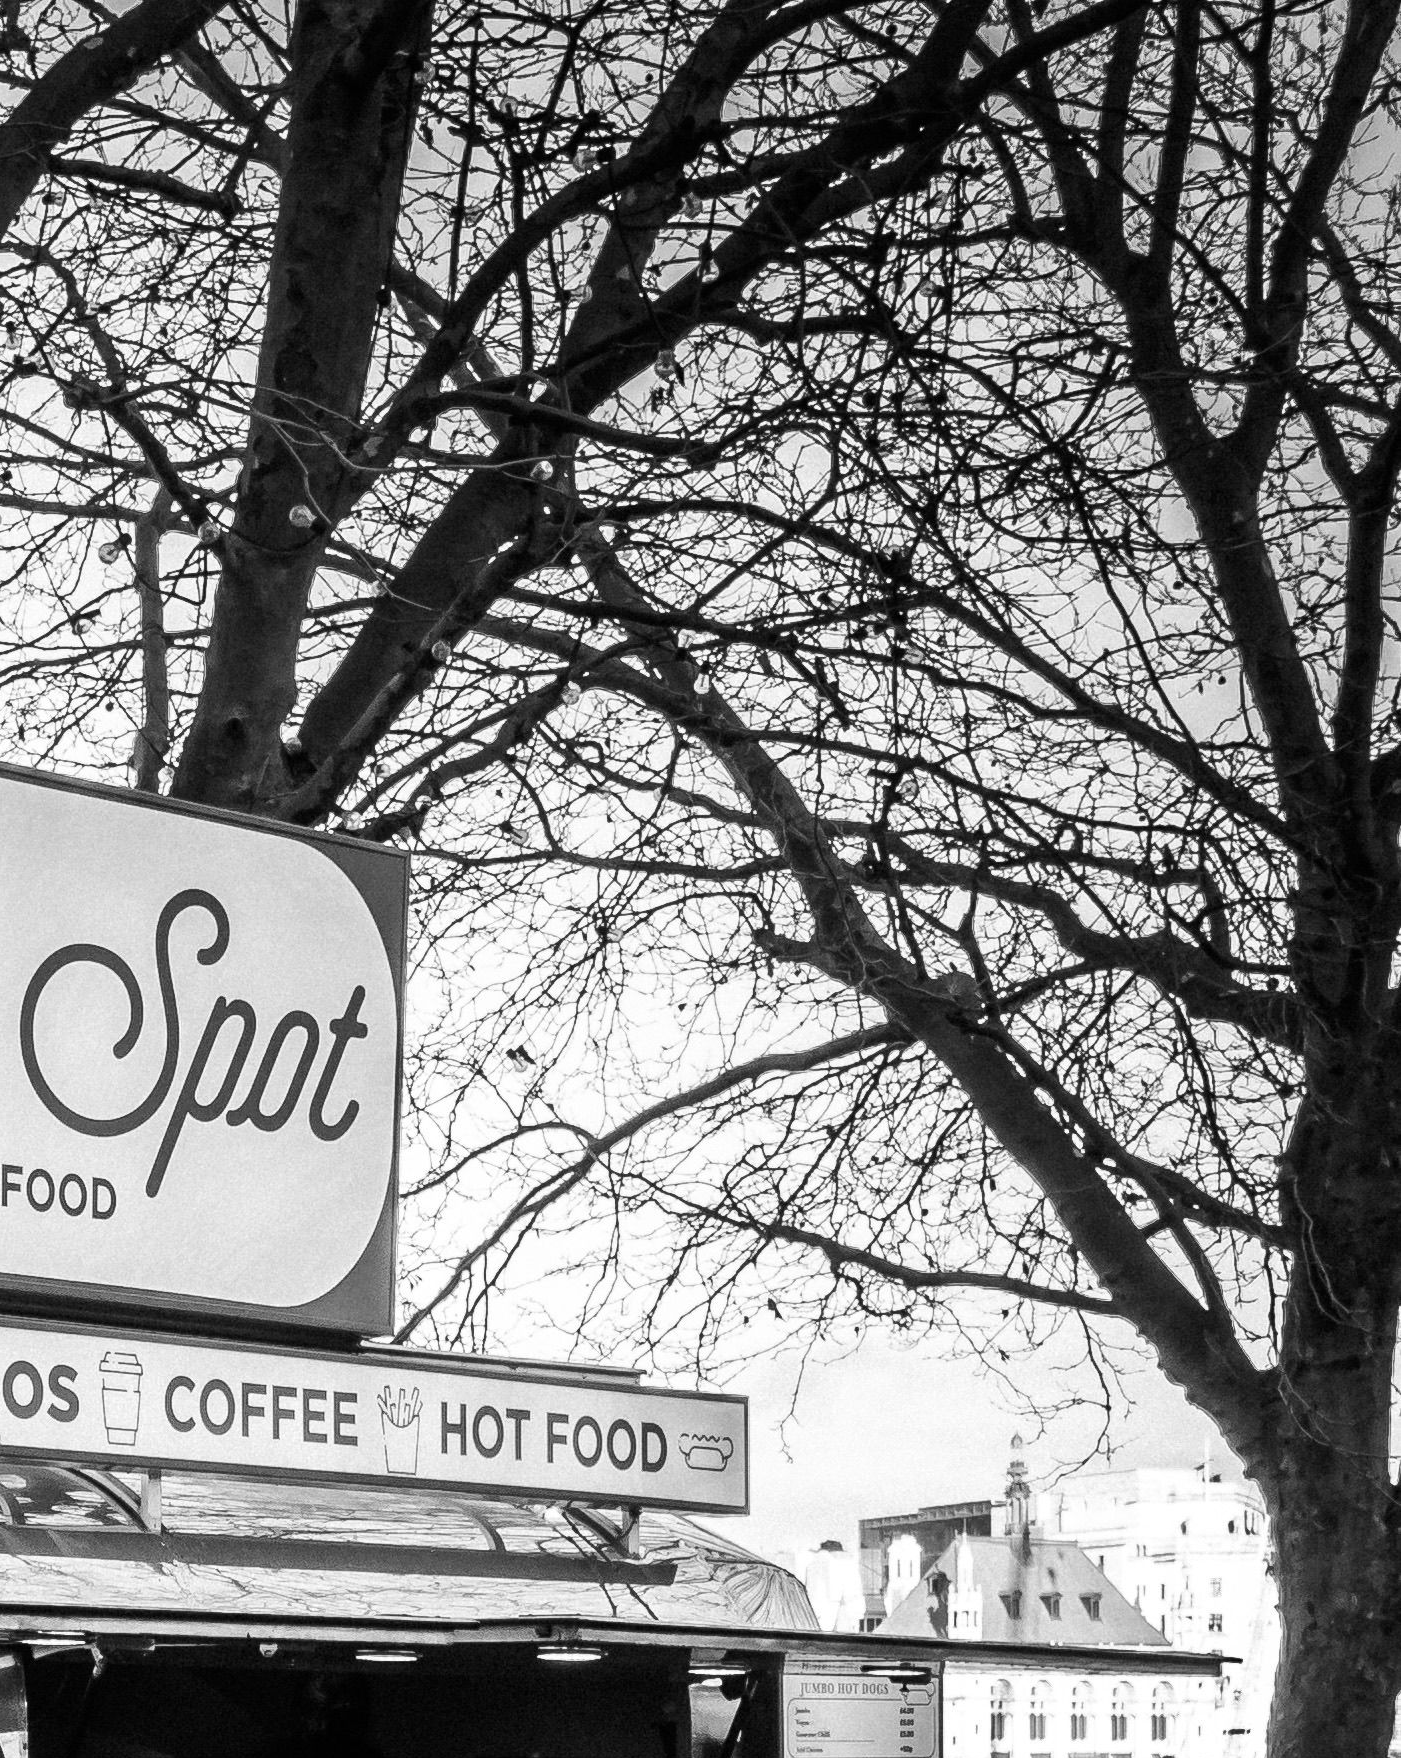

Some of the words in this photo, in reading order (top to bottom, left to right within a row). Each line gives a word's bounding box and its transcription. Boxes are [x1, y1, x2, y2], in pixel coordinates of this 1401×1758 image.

[20, 888, 368, 1198] Spot
[1, 1163, 117, 1221] FOOD
[164, 1375, 358, 1446] COFFEE
[440, 1406, 529, 1460] HOT
[545, 1413, 668, 1474] FOOD
[800, 1683, 834, 1695] JUMBO
[837, 1684, 859, 1694] HOT
[862, 1683, 889, 1695] DOGS
